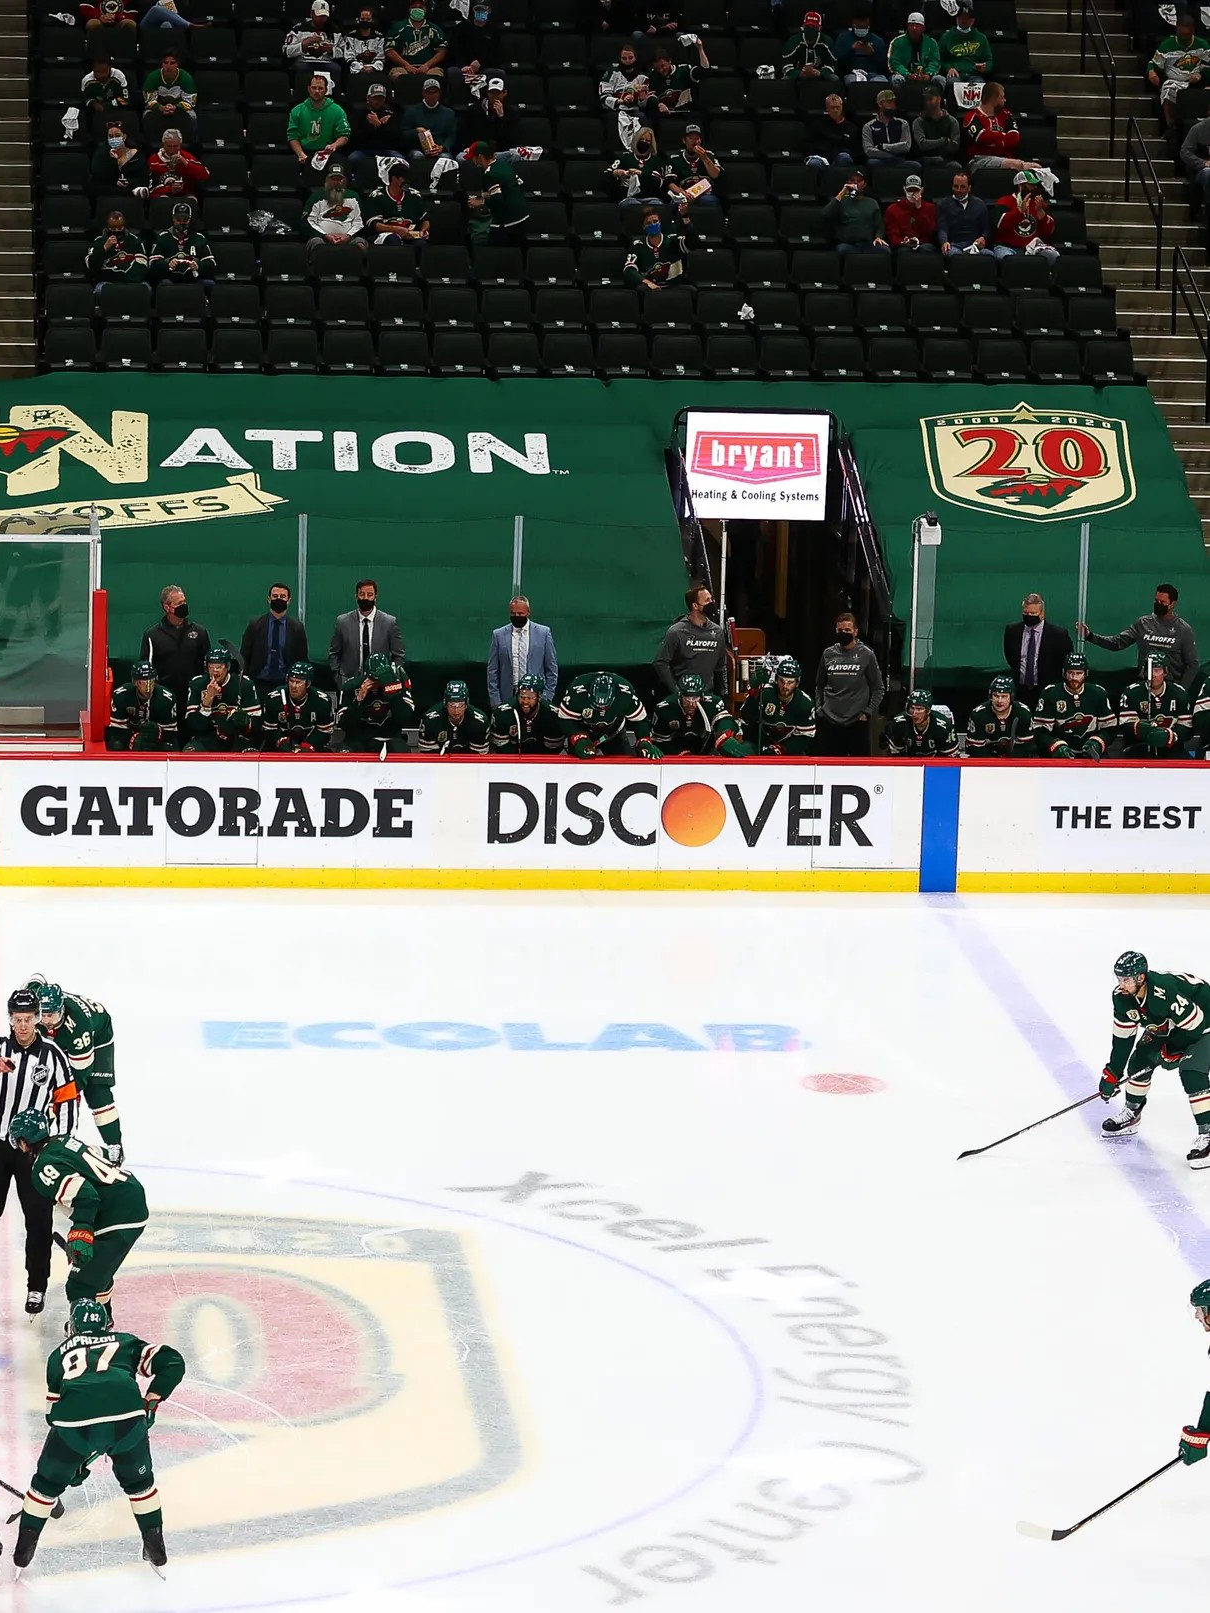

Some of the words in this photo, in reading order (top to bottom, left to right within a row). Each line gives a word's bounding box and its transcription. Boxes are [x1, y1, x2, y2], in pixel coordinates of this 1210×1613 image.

[936, 416, 999, 426] 2000
[1050, 416, 1112, 429] 2020
[710, 439, 805, 472] bryant
[952, 427, 1111, 479] 20
[691, 489, 727, 501] Heating
[730, 490, 738, 500] &
[741, 490, 776, 502] Cooling
[780, 491, 819, 503] Systems
[686, 639, 718, 648] PLAYOFFS
[1143, 633, 1176, 644] PLAYOFFS
[20, 784, 414, 838] GATORADE
[487, 781, 874, 848] DISCOVER
[1050, 806, 1112, 830] THE
[1122, 806, 1202, 830] BEST
[1170, 994, 1189, 1016] 24
[73, 1031, 92, 1050] 36
[201, 1020, 802, 1052] ECOLAB
[38, 1164, 61, 1187] 49
[443, 1169, 771, 1253] Xcel
